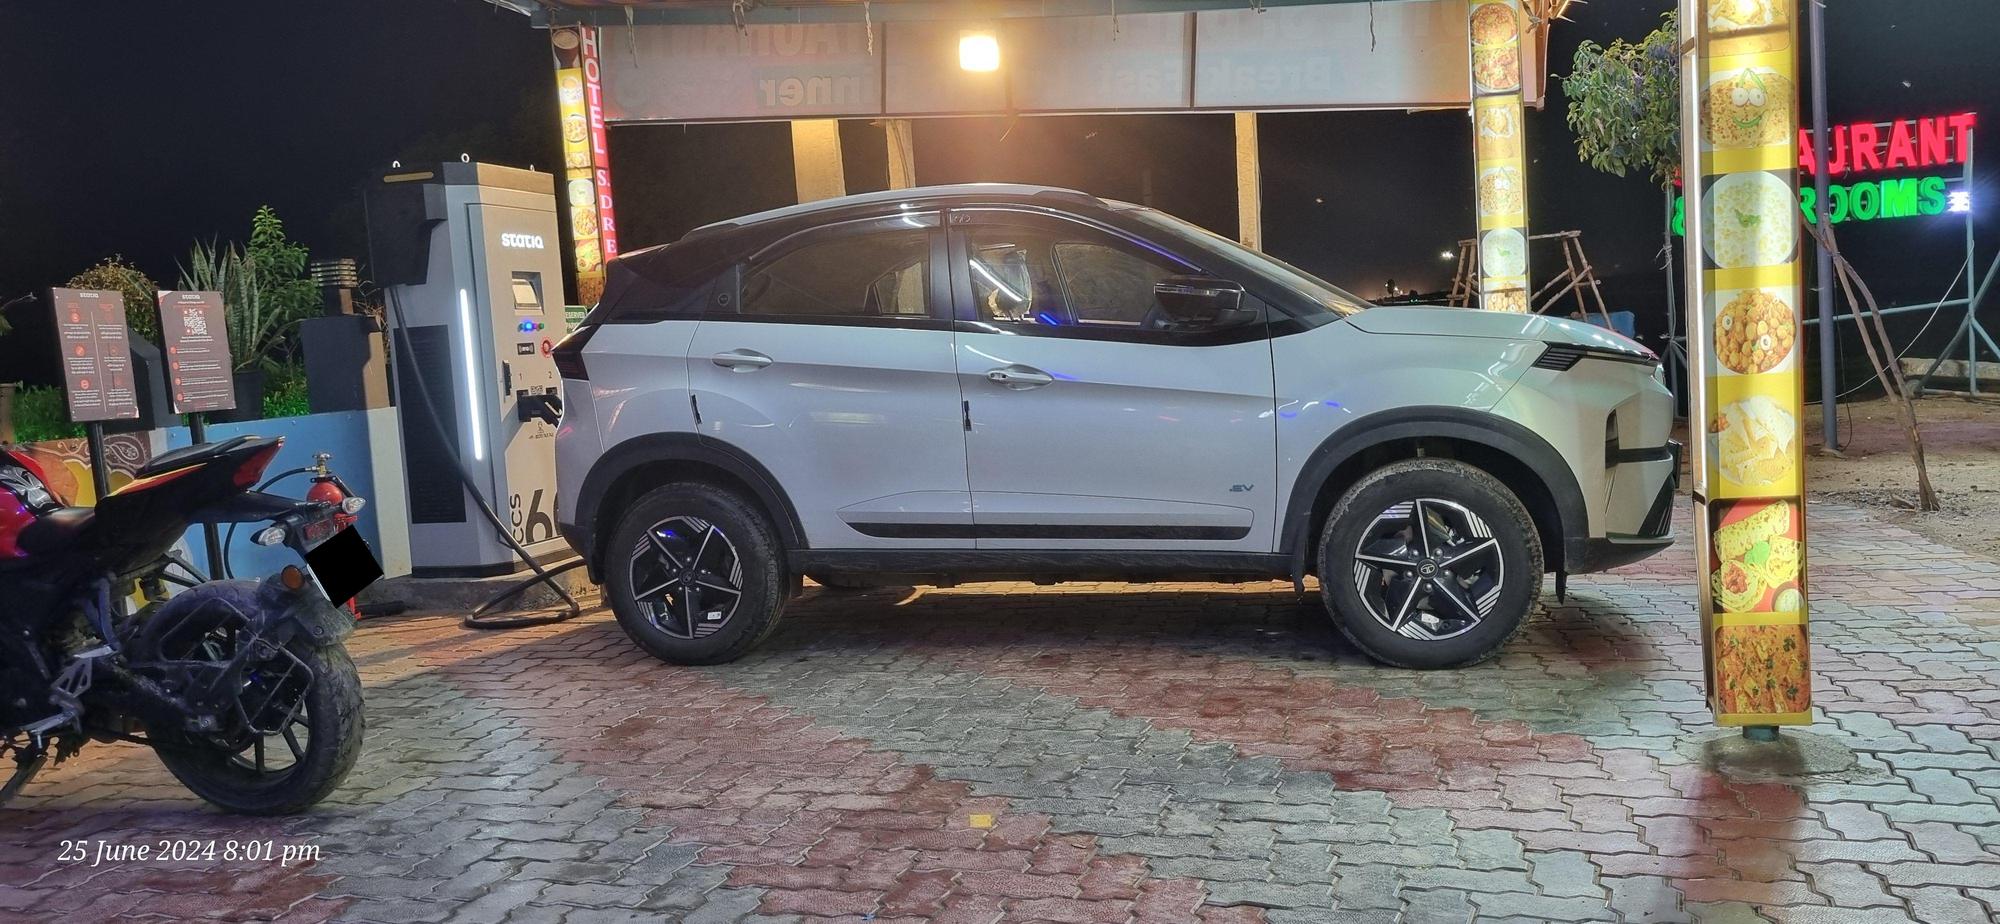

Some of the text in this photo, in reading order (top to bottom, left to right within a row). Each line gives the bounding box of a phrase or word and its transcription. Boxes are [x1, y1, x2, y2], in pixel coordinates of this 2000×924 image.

[581, 27, 605, 155] HOTEL
[1799, 112, 1976, 176] AURANT
[510, 493, 524, 544] CCS
[526, 488, 560, 544] 6
